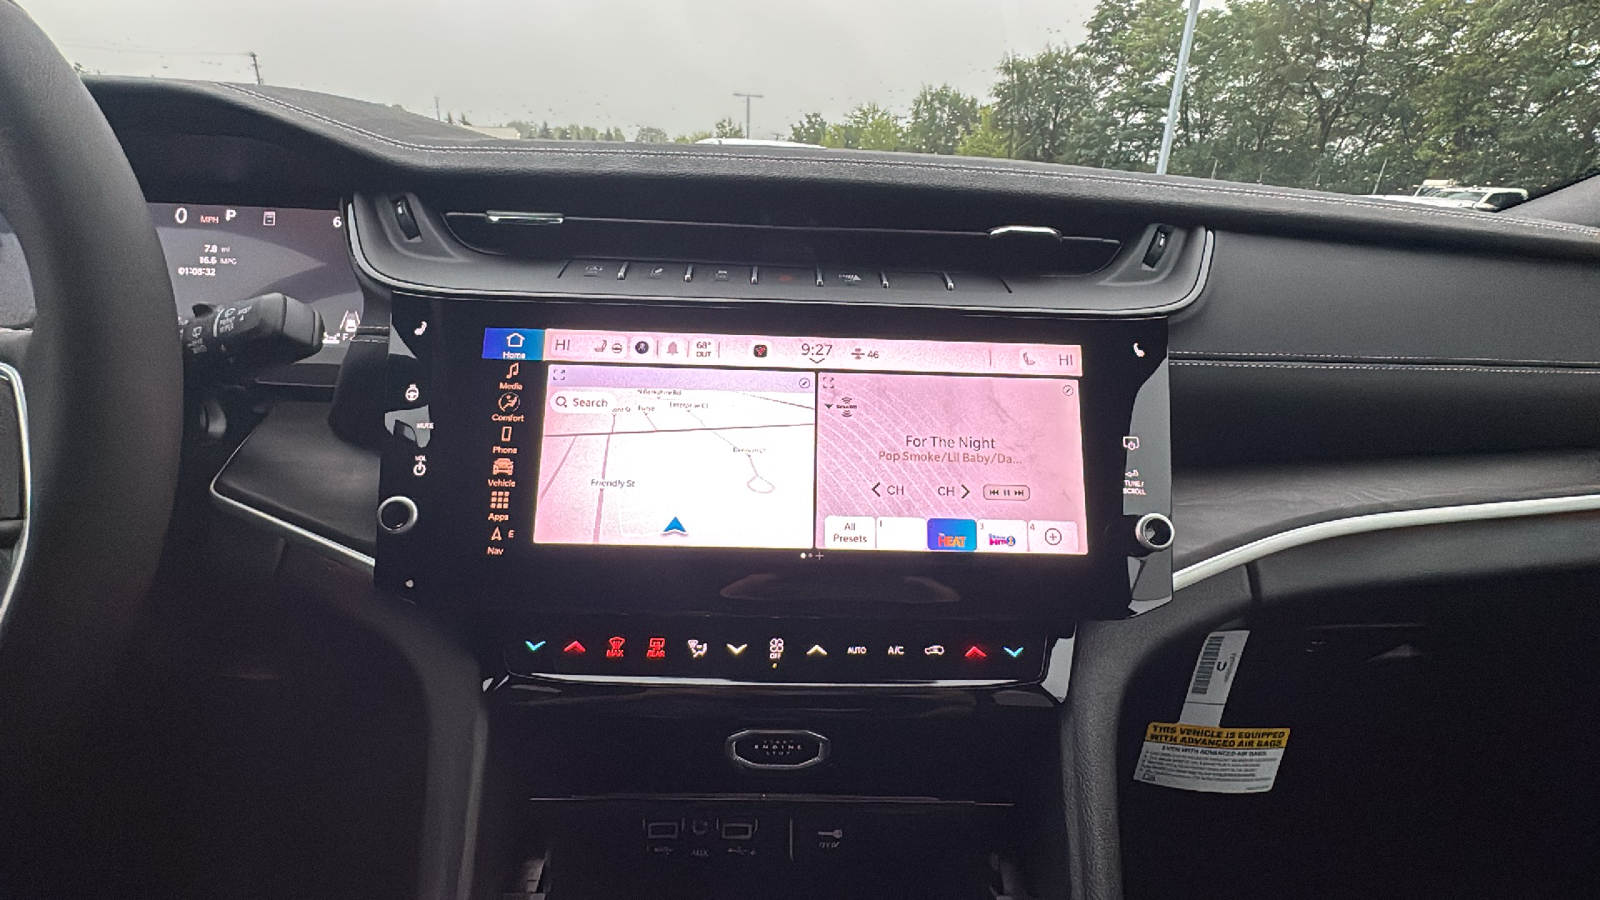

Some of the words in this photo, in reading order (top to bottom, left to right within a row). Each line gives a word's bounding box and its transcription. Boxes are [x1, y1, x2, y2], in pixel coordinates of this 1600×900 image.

[174, 207, 188, 224] 0
[200, 214, 219, 224] MPH
[225, 209, 237, 221] P
[204, 244, 218, 253] 7.8
[554, 339, 571, 351] HI
[801, 343, 834, 356] 9:27
[502, 351, 526, 359] Home
[867, 350, 880, 359] 46
[1058, 354, 1074, 366] HI
[499, 382, 523, 391] Media
[572, 397, 609, 409] Search
[491, 413, 526, 423] Comfort
[906, 435, 928, 448] For
[930, 436, 956, 449] The
[959, 436, 996, 451] Night
[492, 445, 518, 454] Phone
[878, 451, 901, 463] Pop
[903, 451, 961, 464] Smoke/Lil
[487, 479, 516, 488] Vehicle
[590, 478, 625, 489] Friendly
[626, 480, 635, 488] St
[886, 485, 905, 496] CH
[937, 486, 955, 497] CH
[487, 513, 509, 523] Apps
[844, 522, 856, 531] All
[507, 530, 515, 538] E
[833, 533, 868, 544] Presets
[937, 535, 967, 547] HEAT
[487, 547, 504, 555] Nav
[605, 650, 624, 658] MAX
[647, 650, 666, 658] REAR
[847, 646, 868, 655] AUTO
[887, 645, 905, 655] A/C
[1152, 725, 1177, 734] THIS
[1180, 728, 1223, 738] VEHICLE
[1150, 733, 1178, 742] WITH
[1180, 737, 1235, 747] ADVANCED
[1256, 740, 1283, 748] BAGS
